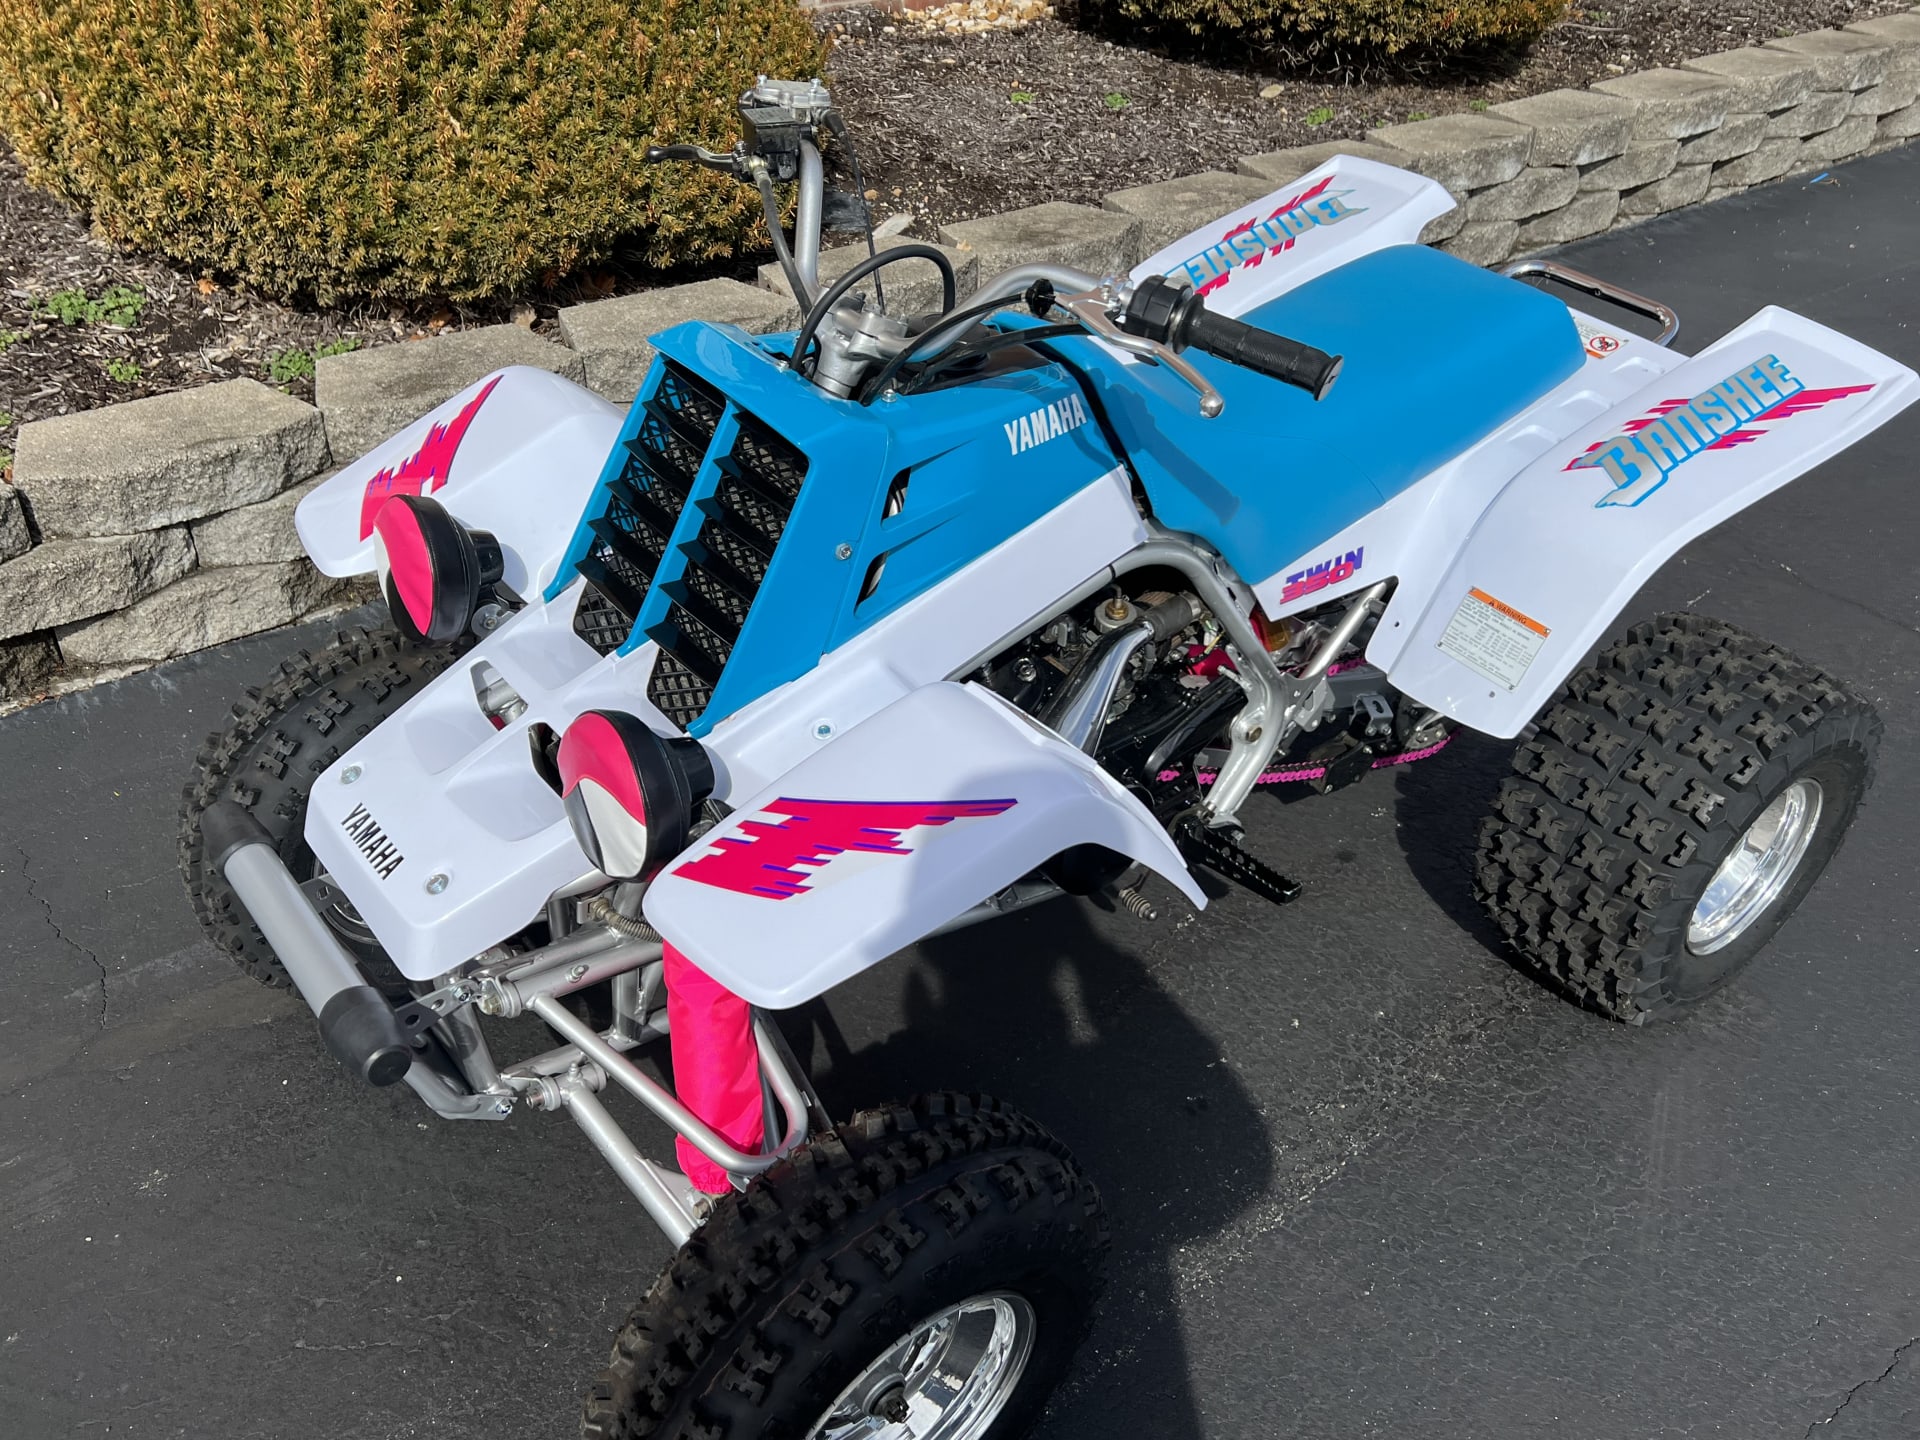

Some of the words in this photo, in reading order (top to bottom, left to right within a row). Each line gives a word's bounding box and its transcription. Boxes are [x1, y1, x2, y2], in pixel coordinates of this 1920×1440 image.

[1003, 393, 1087, 456] YAMAHA
[1571, 354, 1806, 508] BANSHEE
[1280, 561, 1354, 605] 350
[1286, 546, 1364, 584] TWIN
[1496, 602, 1527, 625] WARNING
[341, 802, 404, 880] YAMAHA
